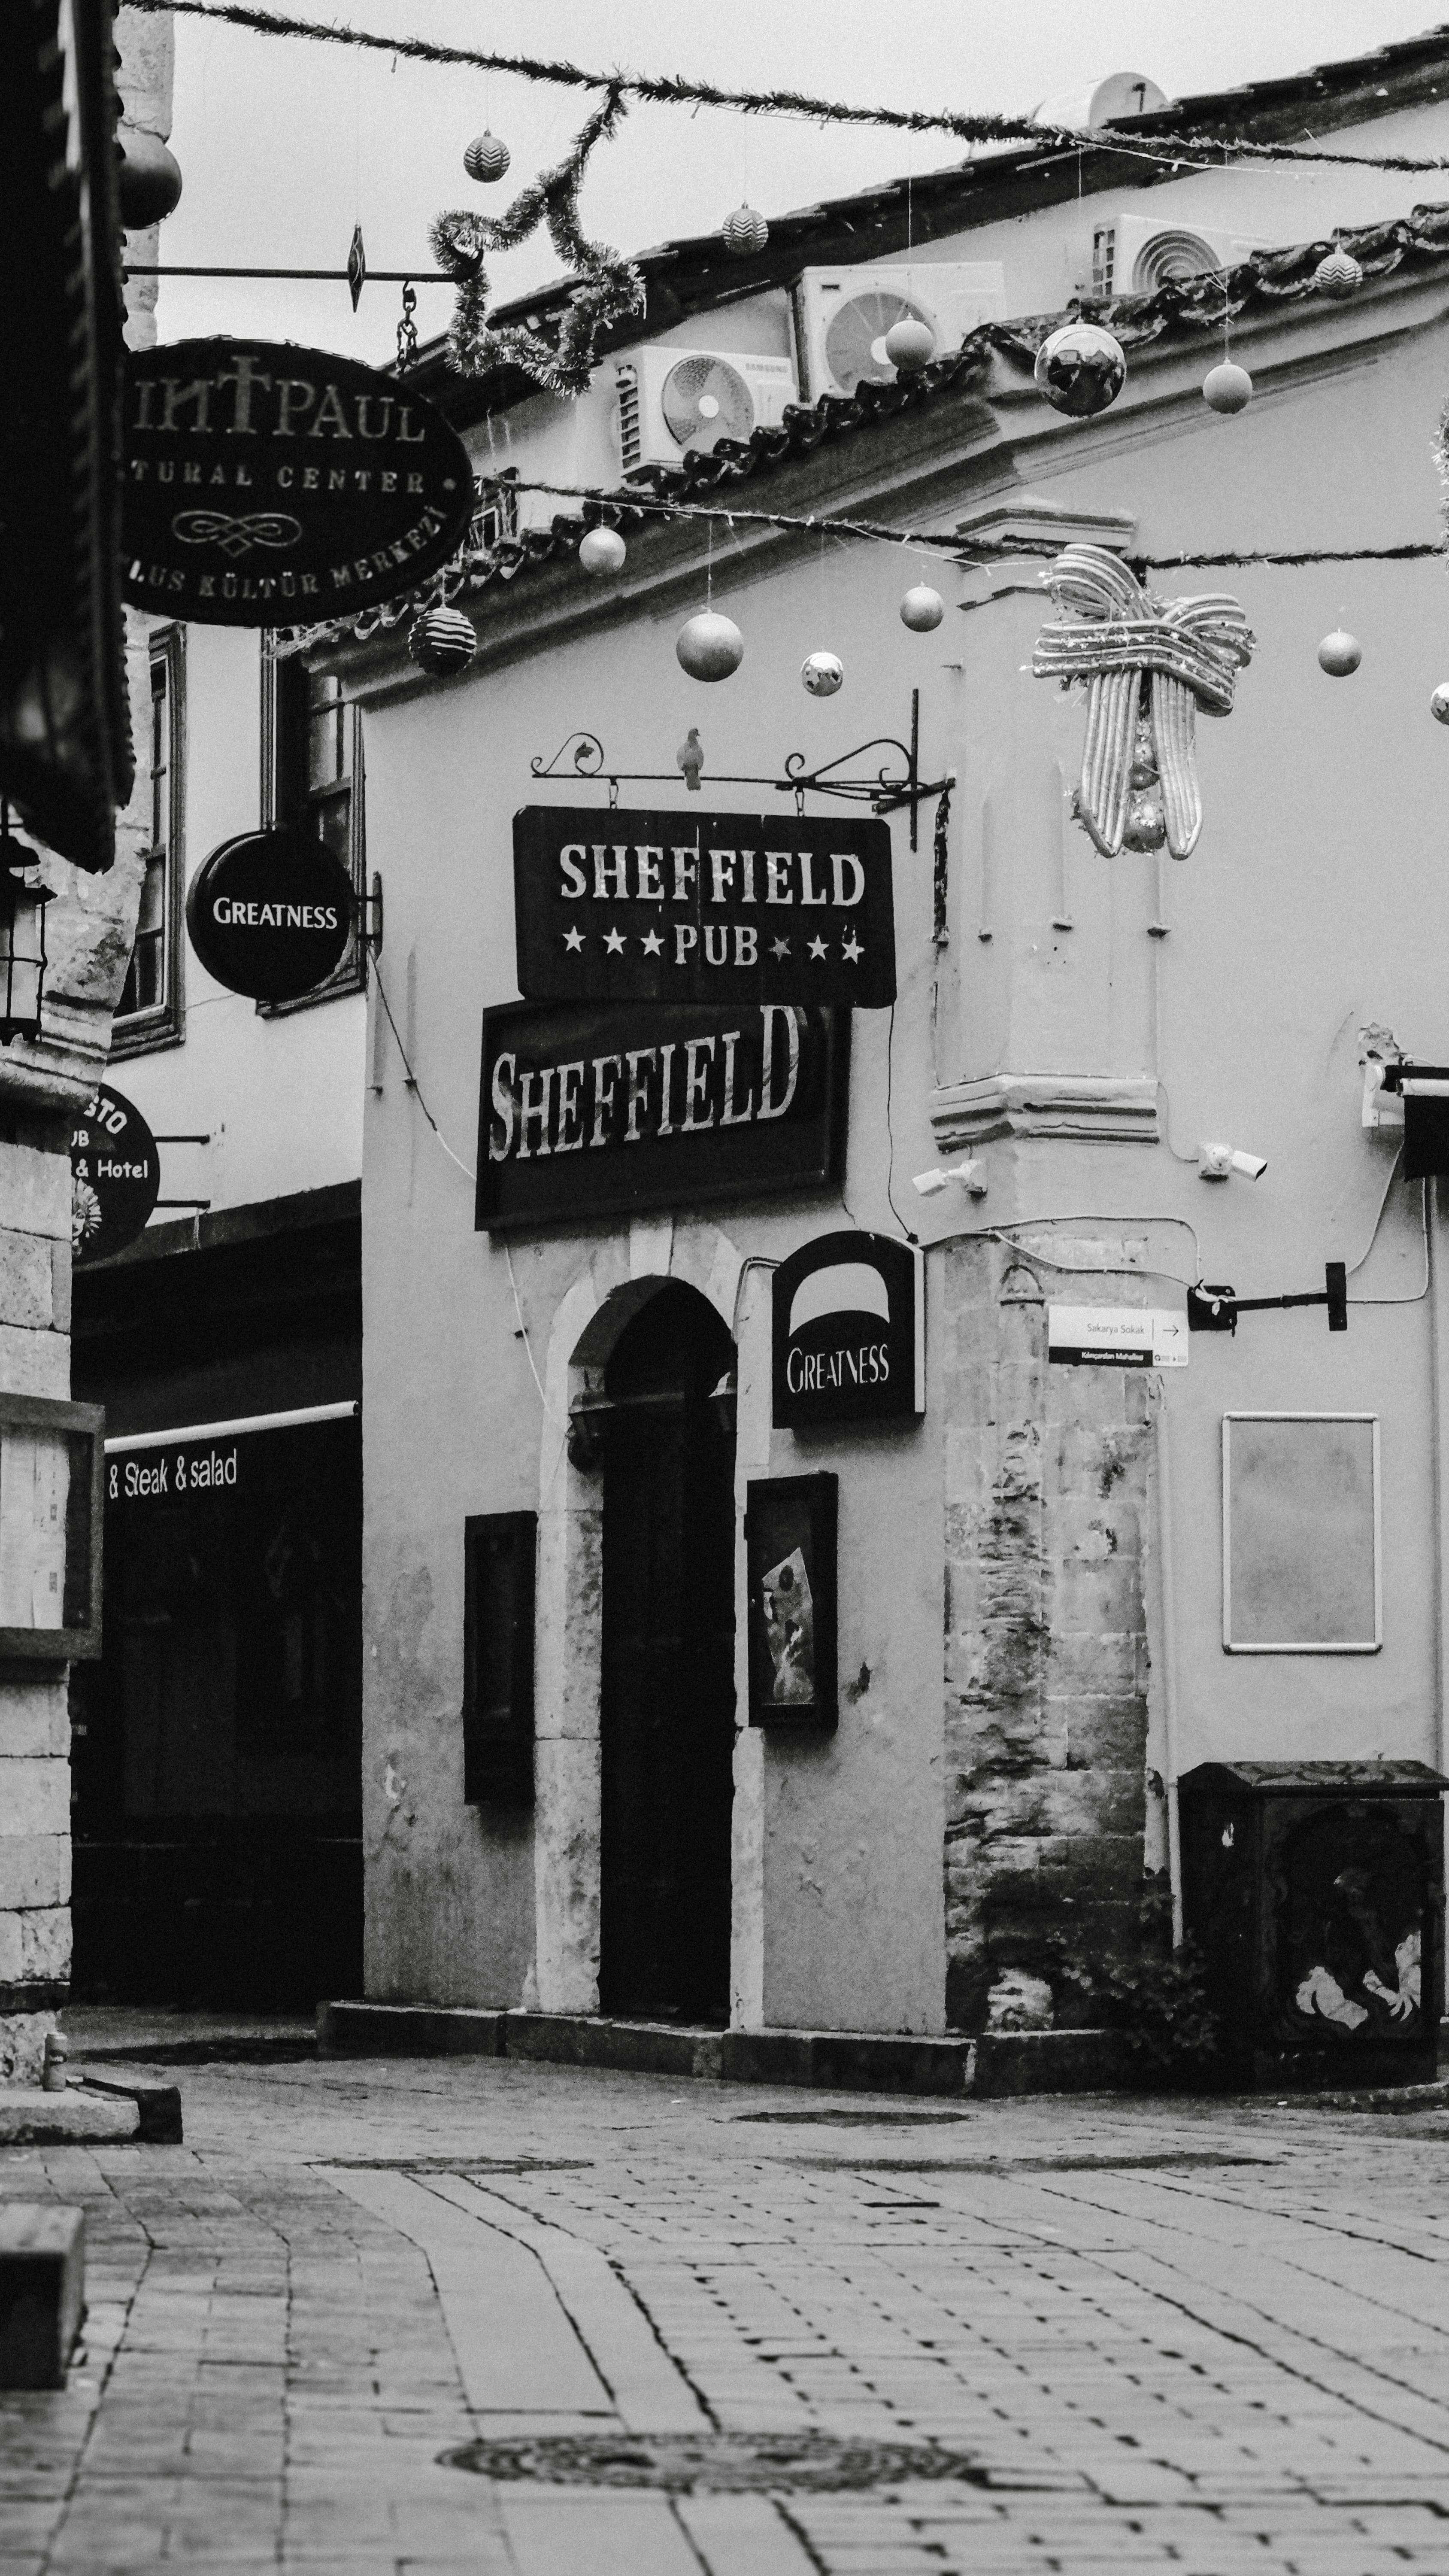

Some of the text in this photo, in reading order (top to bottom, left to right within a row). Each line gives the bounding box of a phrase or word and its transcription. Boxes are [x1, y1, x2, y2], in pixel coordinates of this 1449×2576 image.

[745, 363, 788, 373] SAMSUNG
[272, 379, 425, 442] PAUL
[277, 466, 424, 494] CENTER
[199, 571, 318, 599] KÜLTÜR
[559, 844, 865, 907] SHEFFIELD
[213, 897, 338, 929] GREATNESS
[674, 924, 758, 966] PUB
[488, 1005, 799, 1161] SHEFFIELD
[76, 1158, 149, 1179] & Hotel
[1087, 1323, 1145, 1335] Sakarya Sokak
[787, 1343, 889, 1394] GREATNESS
[109, 1448, 237, 1499] & Steak & salad
